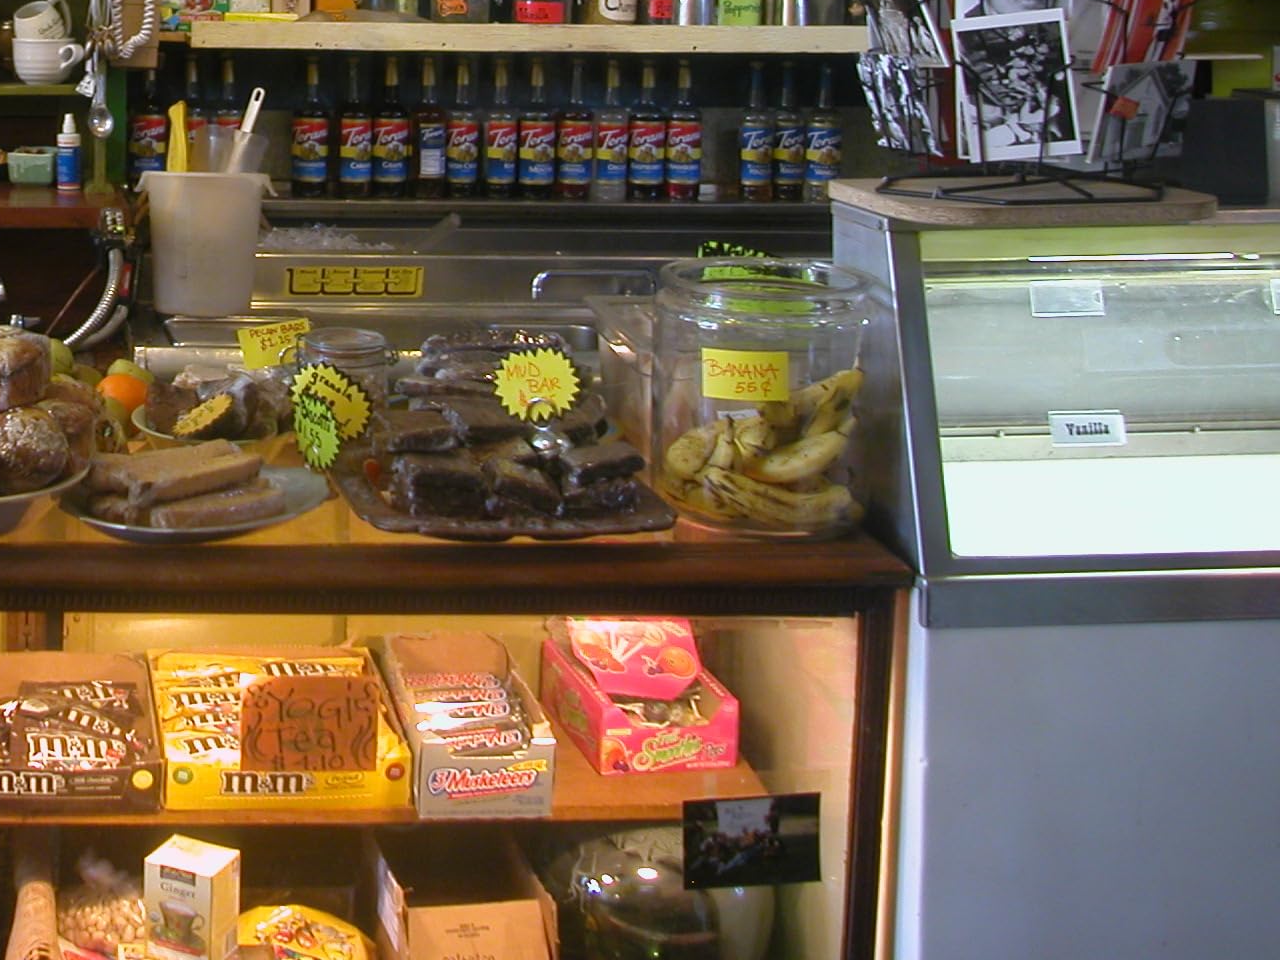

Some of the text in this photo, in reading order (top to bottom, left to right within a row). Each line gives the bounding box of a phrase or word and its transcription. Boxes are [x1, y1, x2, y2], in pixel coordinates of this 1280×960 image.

[506, 361, 540, 381] MUD
[703, 358, 780, 380] BANANA
[526, 376, 561, 393] BAR
[1065, 422, 1109, 436] Vanilla
[273, 726, 336, 752] Tea
[448, 769, 538, 797] Musketeers
